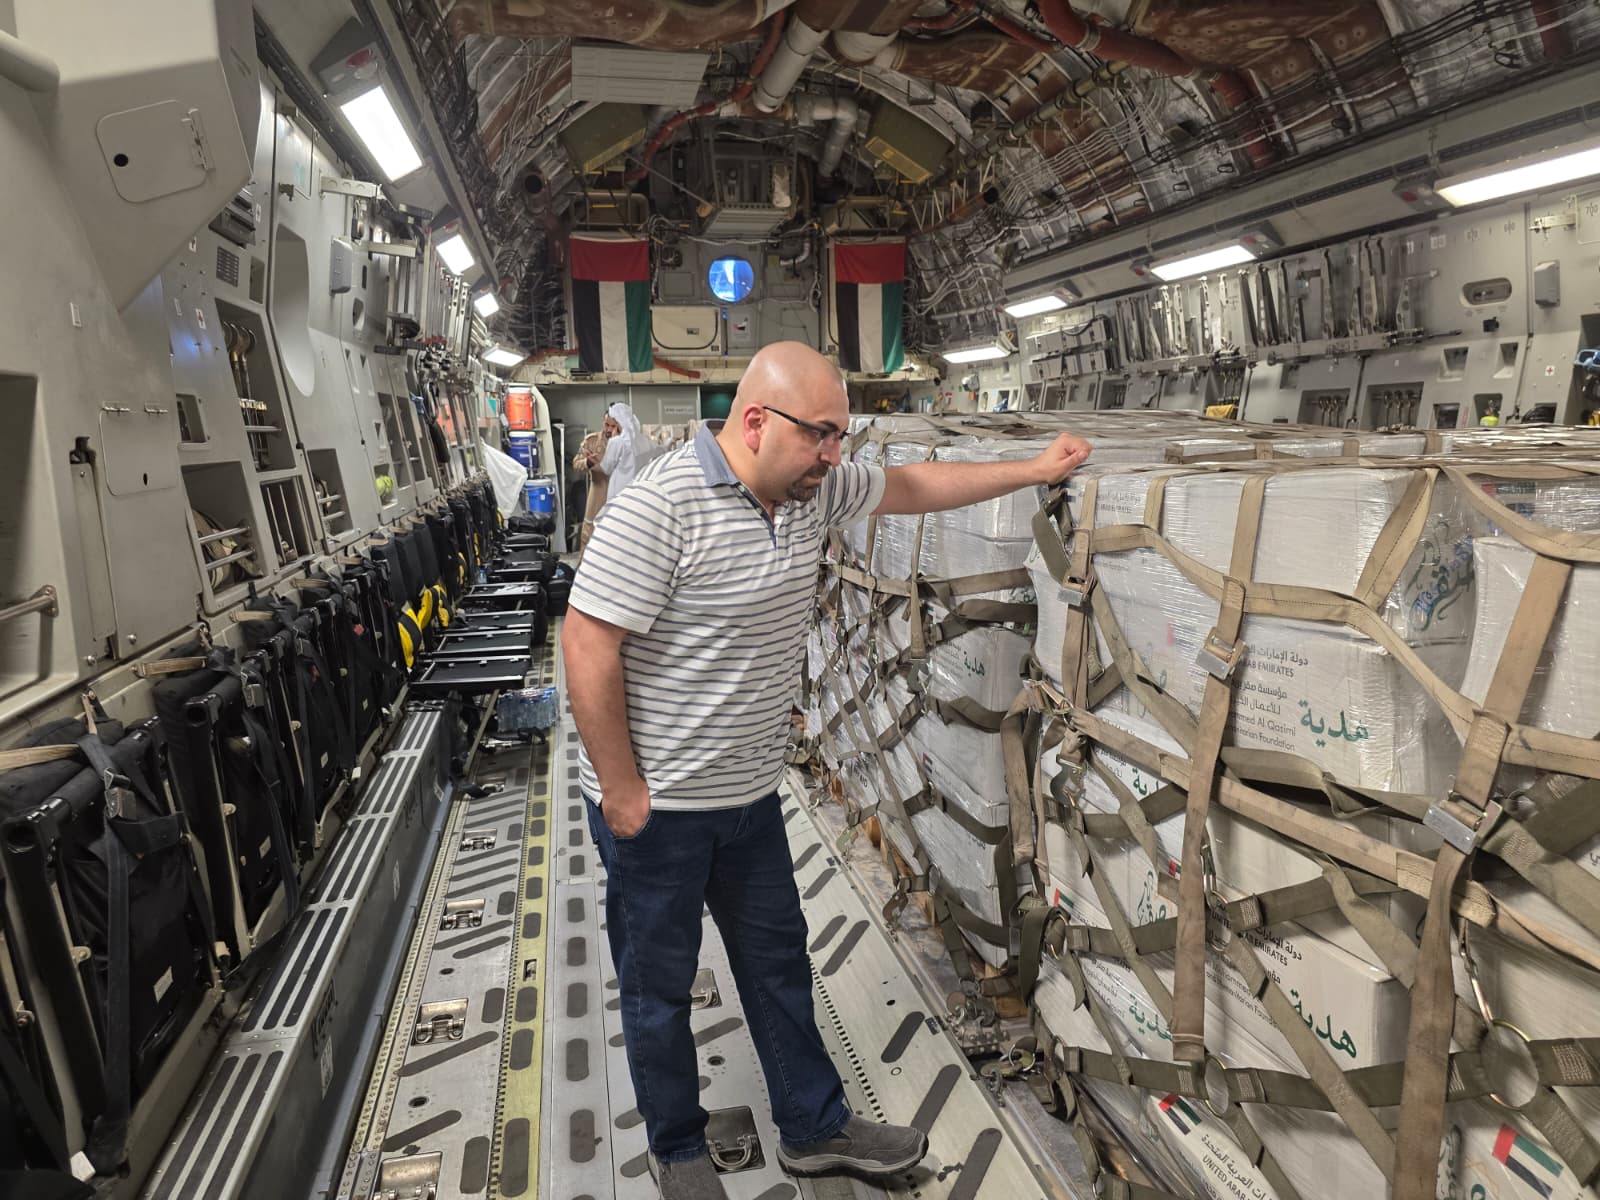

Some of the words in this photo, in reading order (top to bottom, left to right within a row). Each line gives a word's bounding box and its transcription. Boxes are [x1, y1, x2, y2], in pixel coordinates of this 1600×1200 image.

[1257, 647, 1289, 664] الإمارات
[1290, 650, 1309, 667] دولة
[1258, 661, 1295, 678] EMIRATES
[1267, 720, 1296, 737] Qasimi
[1298, 699, 1369, 748] هدية
[1254, 940, 1288, 966] EMIRATES
[1285, 941, 1302, 960] دولة
[1202, 1154, 1228, 1183] UNITED
